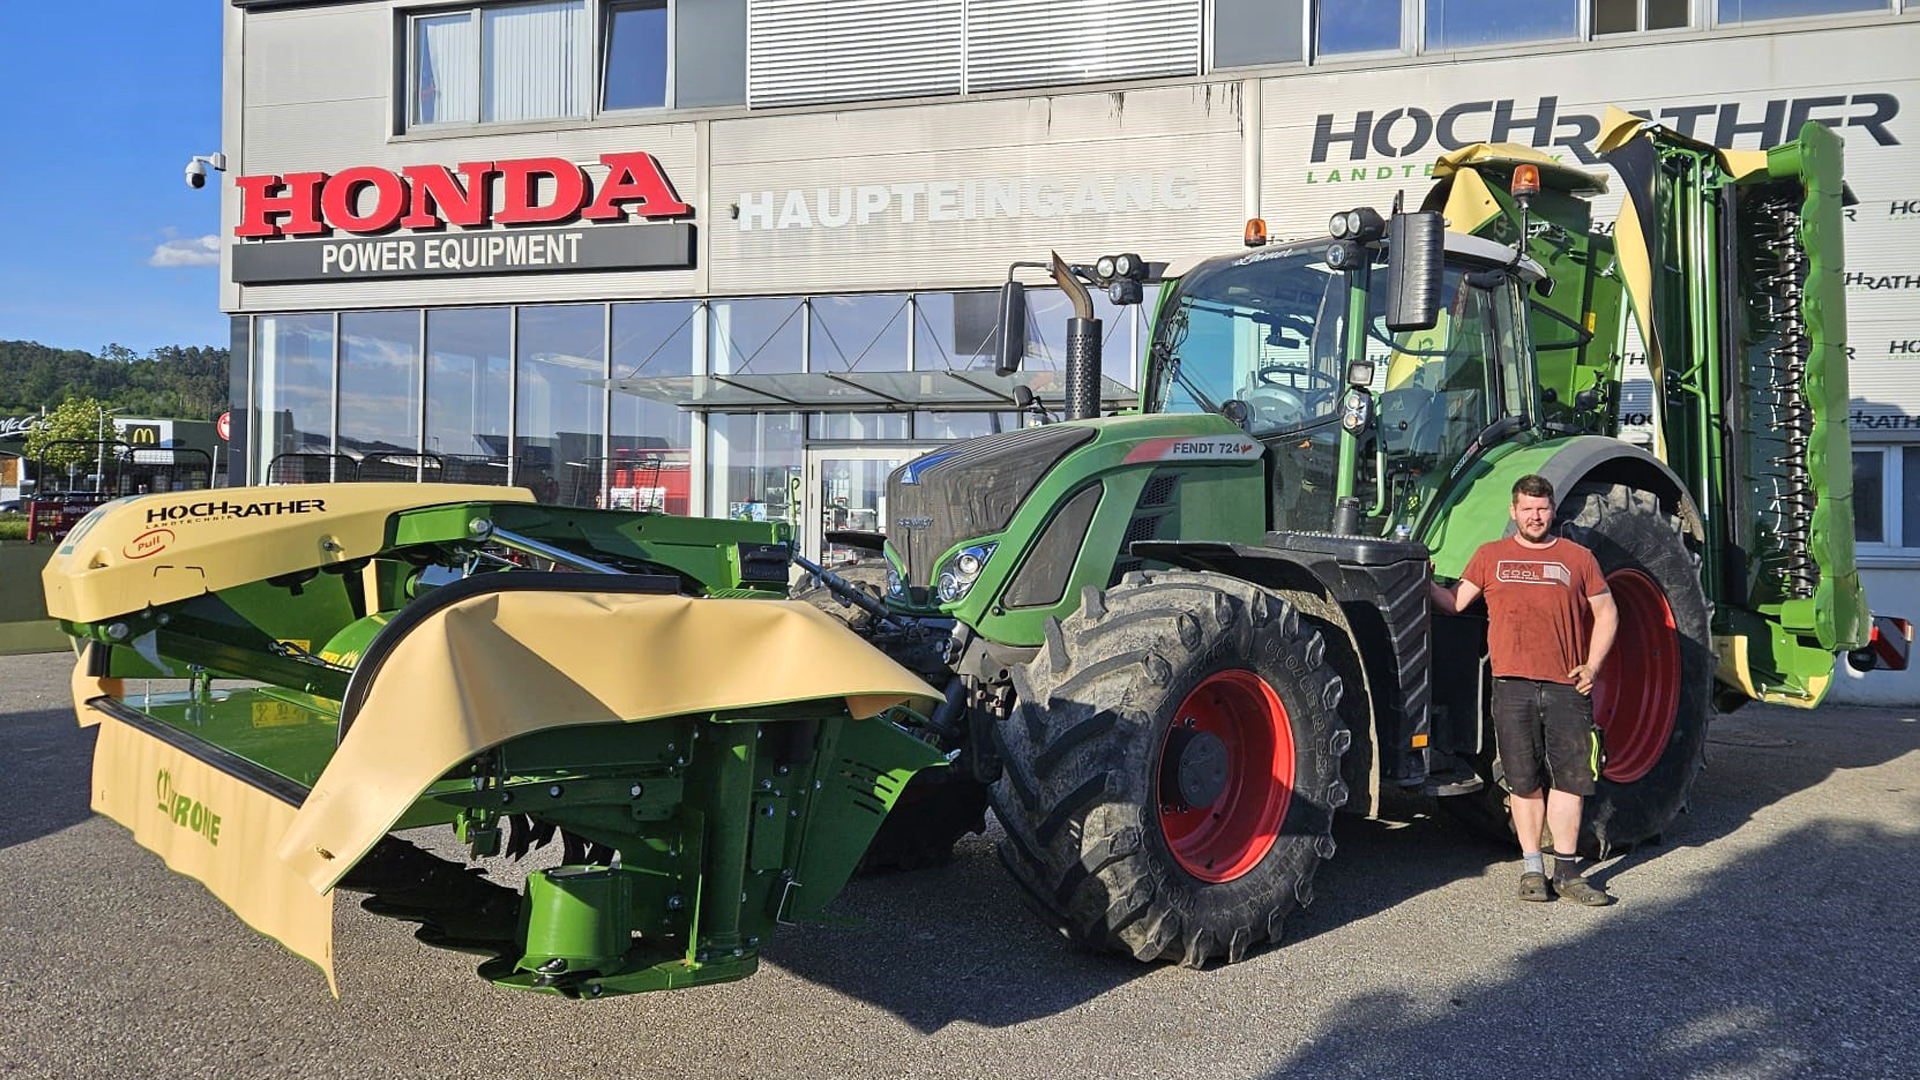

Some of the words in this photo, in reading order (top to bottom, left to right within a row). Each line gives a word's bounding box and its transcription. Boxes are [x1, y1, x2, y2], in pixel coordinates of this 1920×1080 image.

[1310, 92, 1903, 165] HOCHRTHER
[234, 151, 693, 239] HONDA
[738, 167, 1199, 231] HAUPTEINGANG
[322, 239, 416, 274] POWER
[423, 232, 583, 269] EQUIPMENT
[1173, 443, 1214, 454] FENDT
[1219, 443, 1240, 454] 724
[145, 515, 233, 529] LANDTECHNIK
[147, 499, 327, 524] HOCHRATHER
[137, 535, 160, 552] Pull
[1501, 569, 1540, 578] COOL
[169, 789, 222, 848] KRONE
